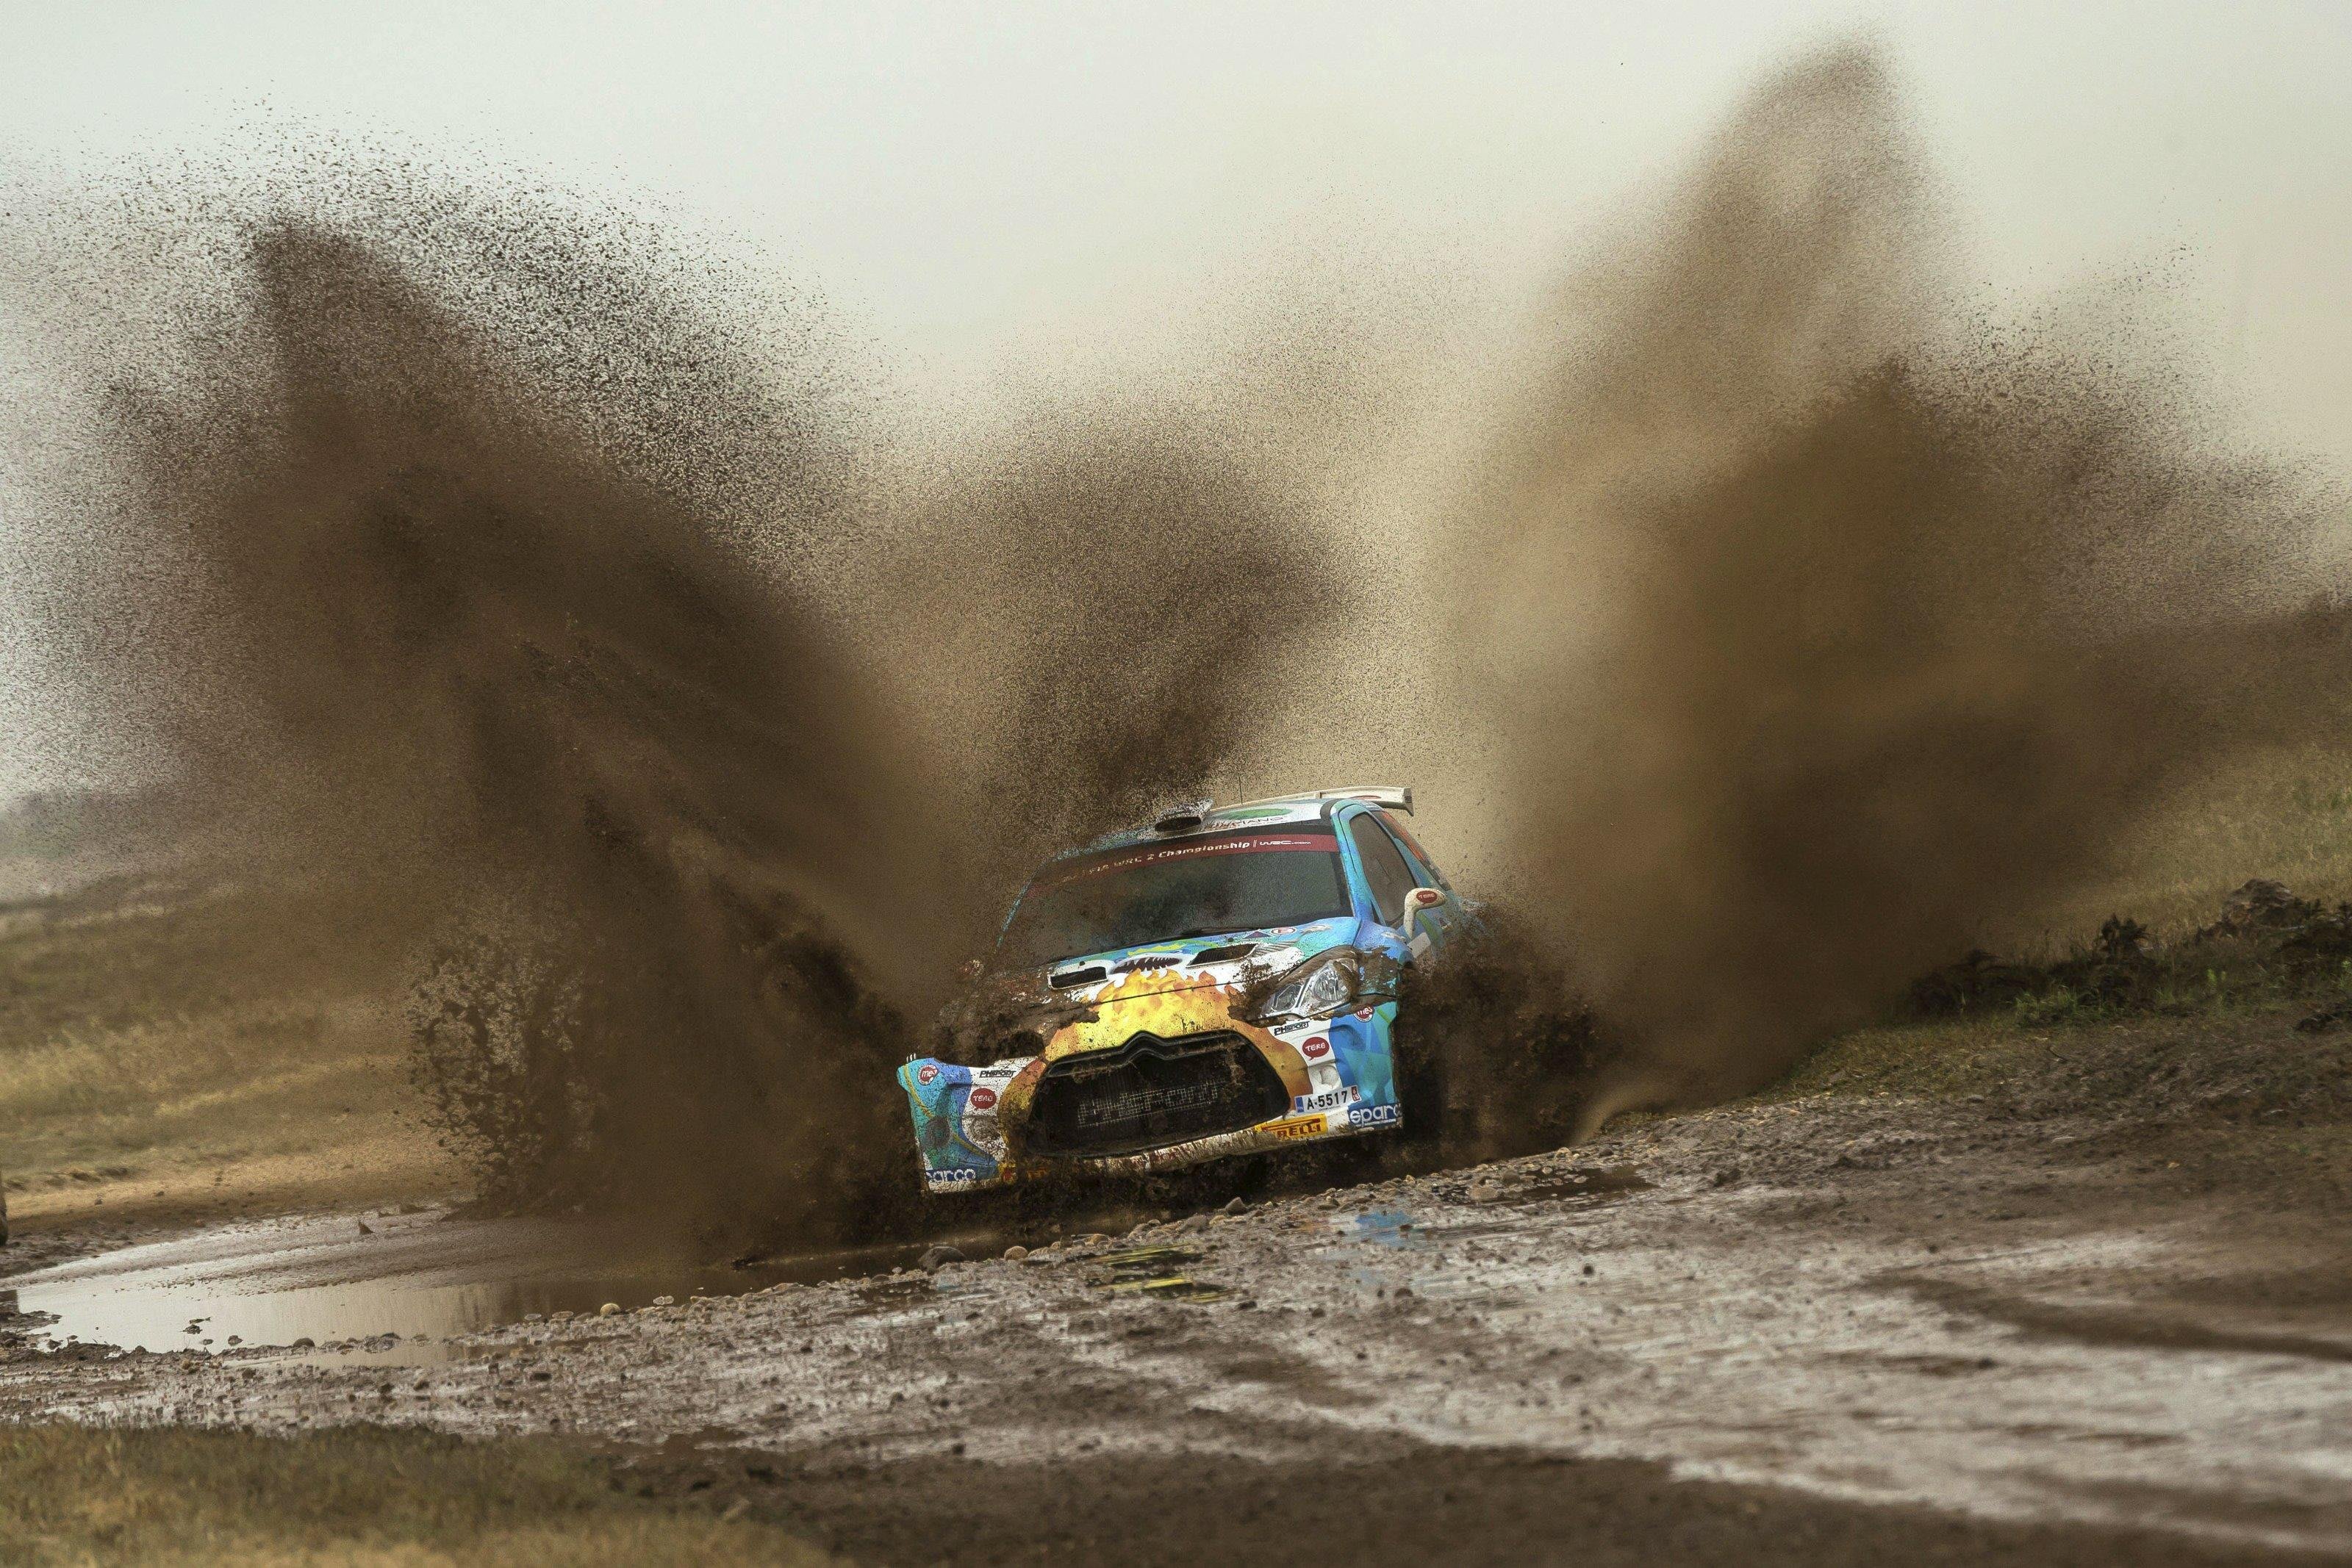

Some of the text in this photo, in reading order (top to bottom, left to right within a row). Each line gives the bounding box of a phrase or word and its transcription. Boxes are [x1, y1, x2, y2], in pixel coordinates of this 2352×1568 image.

[1158, 841, 1250, 859] Championship
[1274, 1020, 1311, 1036] PHSPORT
[1305, 1042, 1327, 1053] TERE
[926, 1168, 976, 1183] arco
